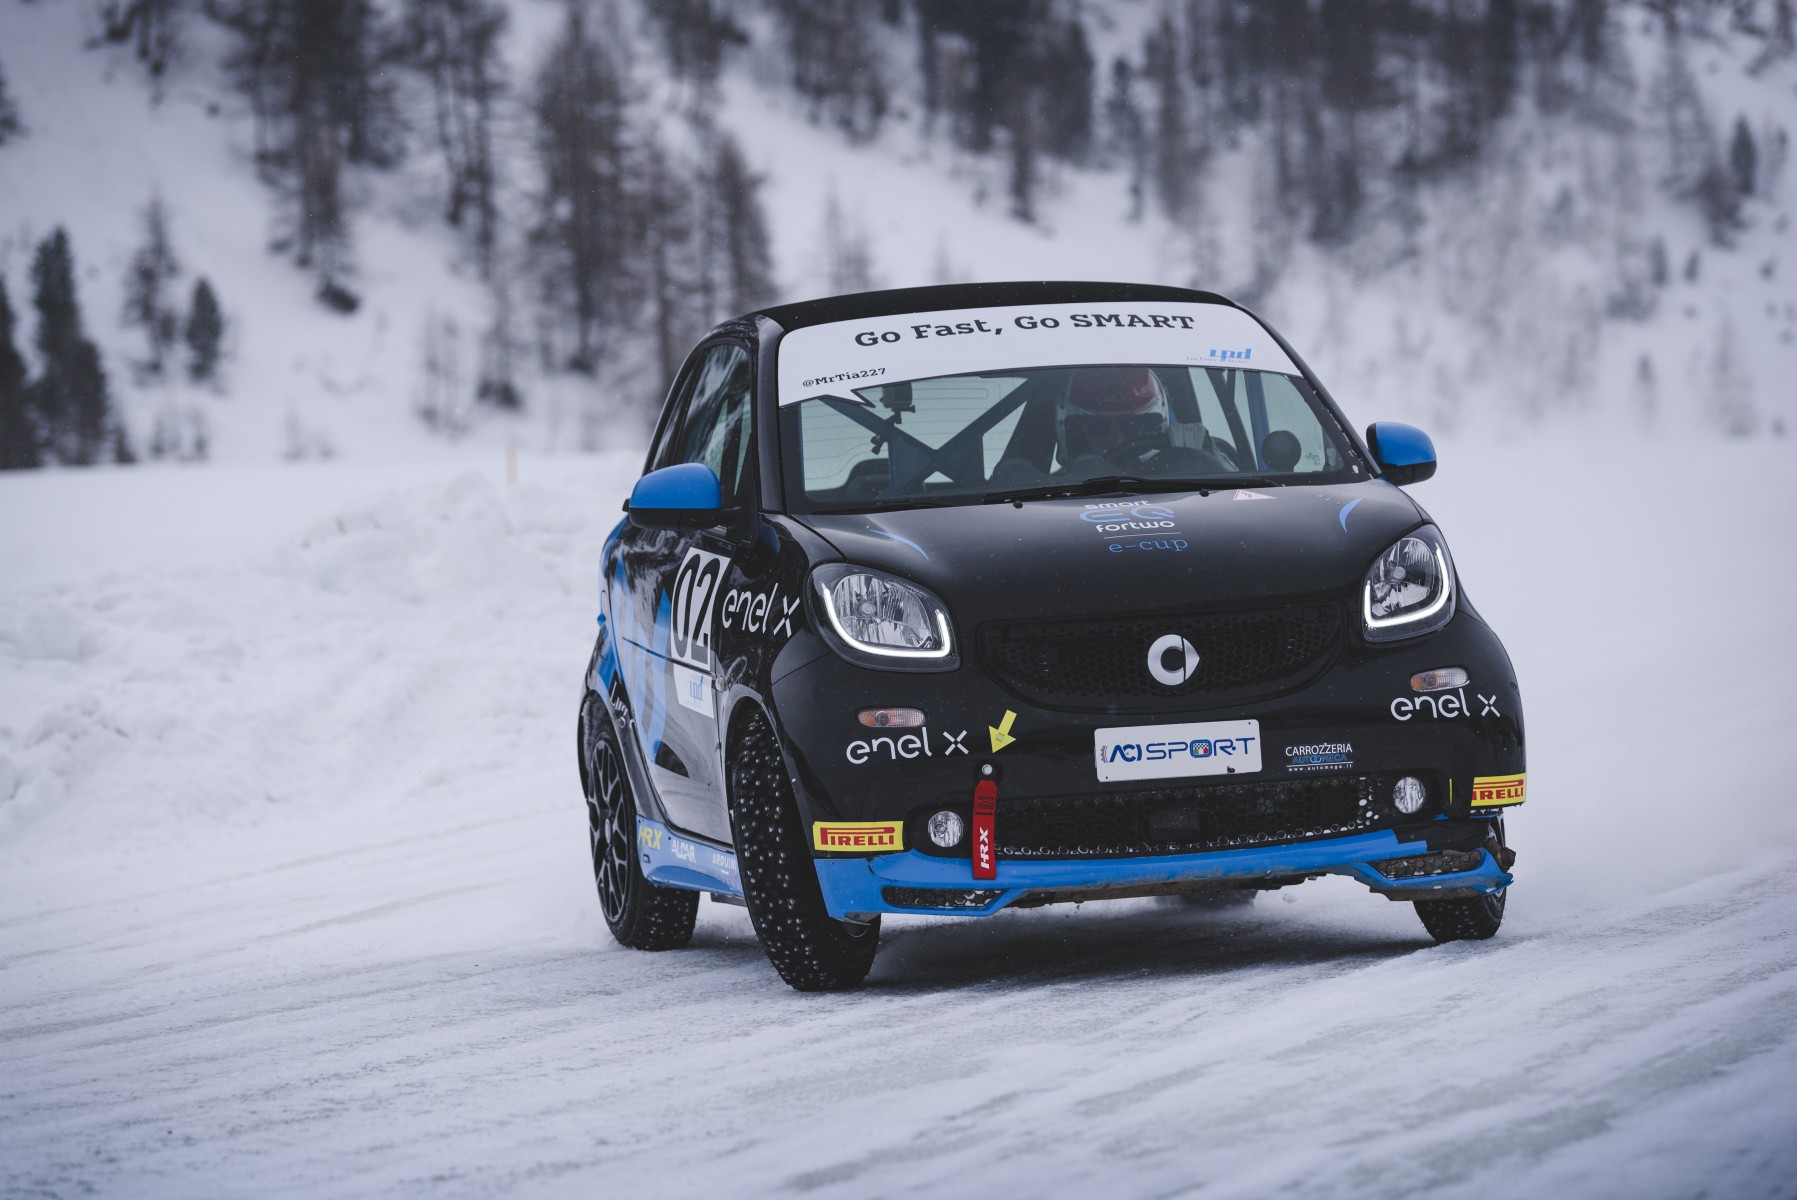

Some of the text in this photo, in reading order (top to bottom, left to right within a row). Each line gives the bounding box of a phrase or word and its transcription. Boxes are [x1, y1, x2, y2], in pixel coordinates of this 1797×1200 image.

[855, 314, 1195, 346] Go Fast, Go SMART
[802, 367, 886, 388] @MrTia227
[1083, 500, 1152, 510] smart
[1095, 520, 1175, 533] fortwo
[1108, 538, 1188, 553] e-cup
[673, 553, 721, 666] 02
[722, 582, 778, 635] enel
[1390, 687, 1471, 721] enel
[846, 726, 933, 764] enel
[1109, 737, 1256, 763] ACI SPORT
[1285, 742, 1353, 757] CARROZZERIA
[819, 826, 896, 846] PIRELLI
[979, 826, 991, 870] HRX
